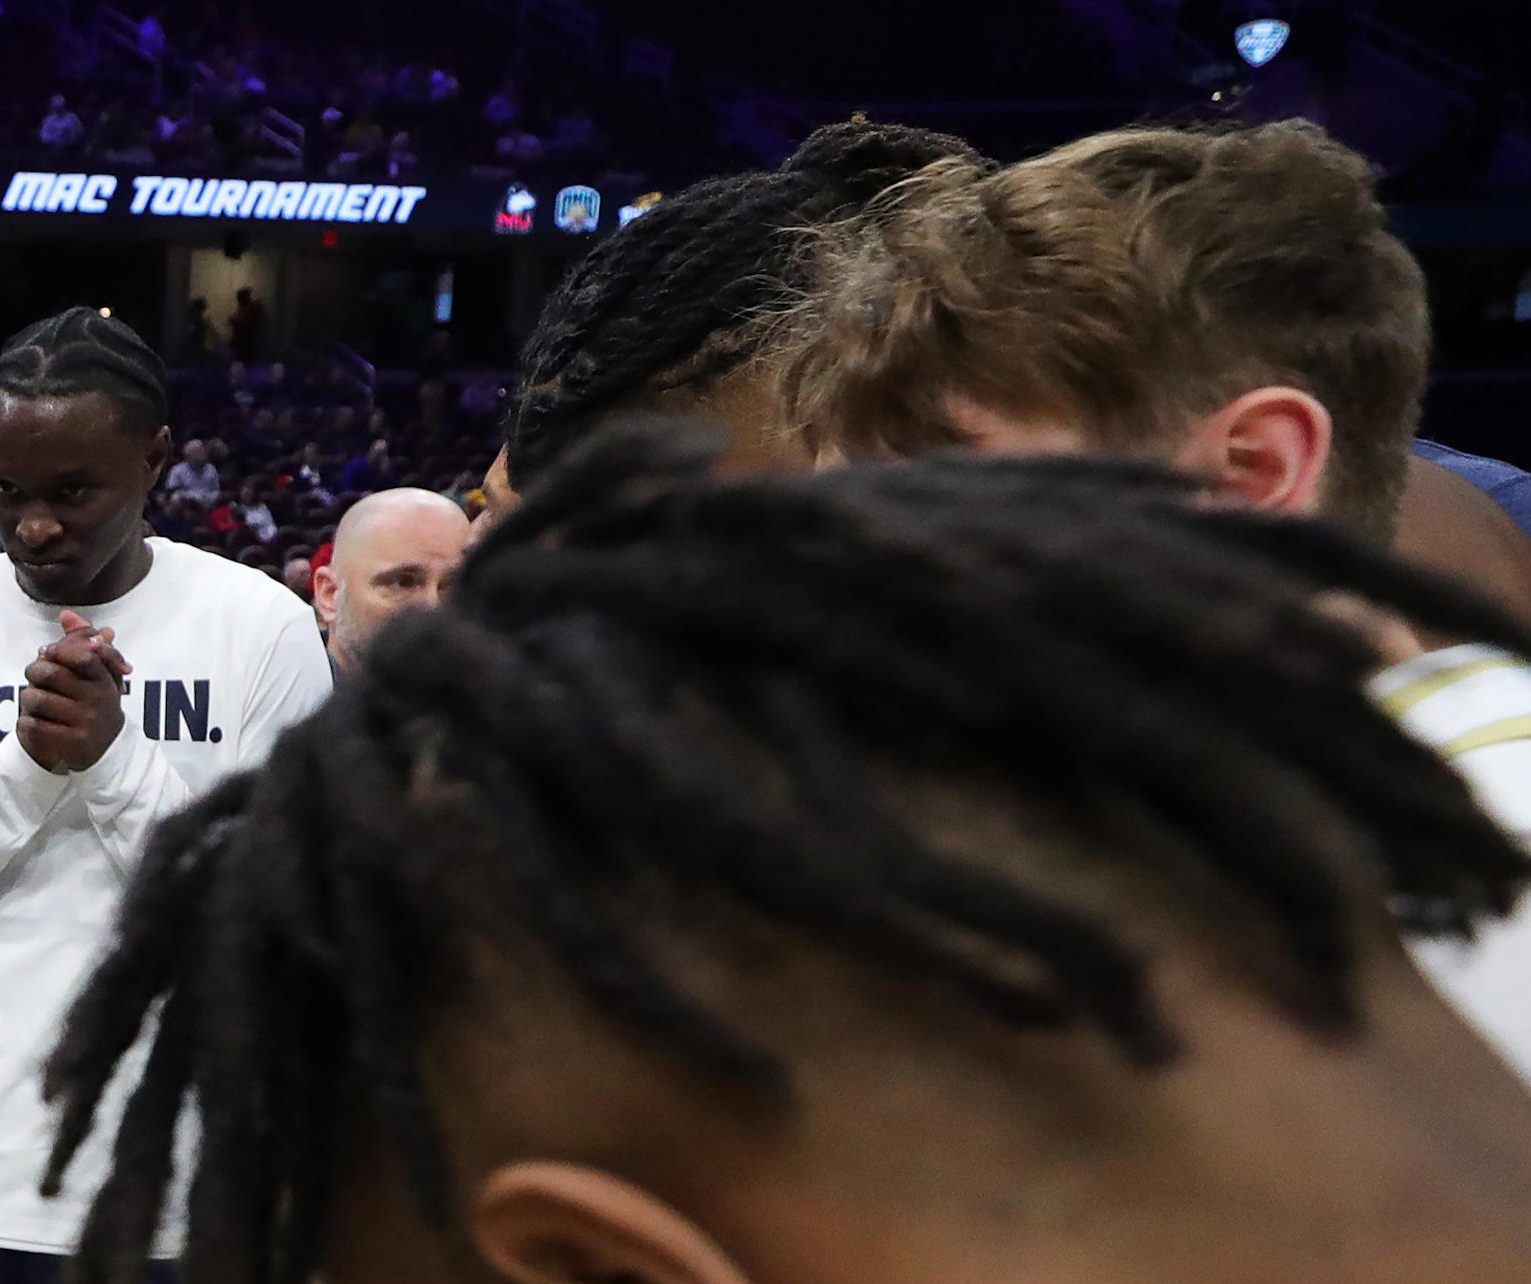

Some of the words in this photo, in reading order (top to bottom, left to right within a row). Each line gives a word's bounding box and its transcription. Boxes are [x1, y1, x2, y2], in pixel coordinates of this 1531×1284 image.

[1, 171, 118, 213] MAC
[130, 176, 427, 224] TOURNAMENT
[142, 679, 223, 743] IN.
